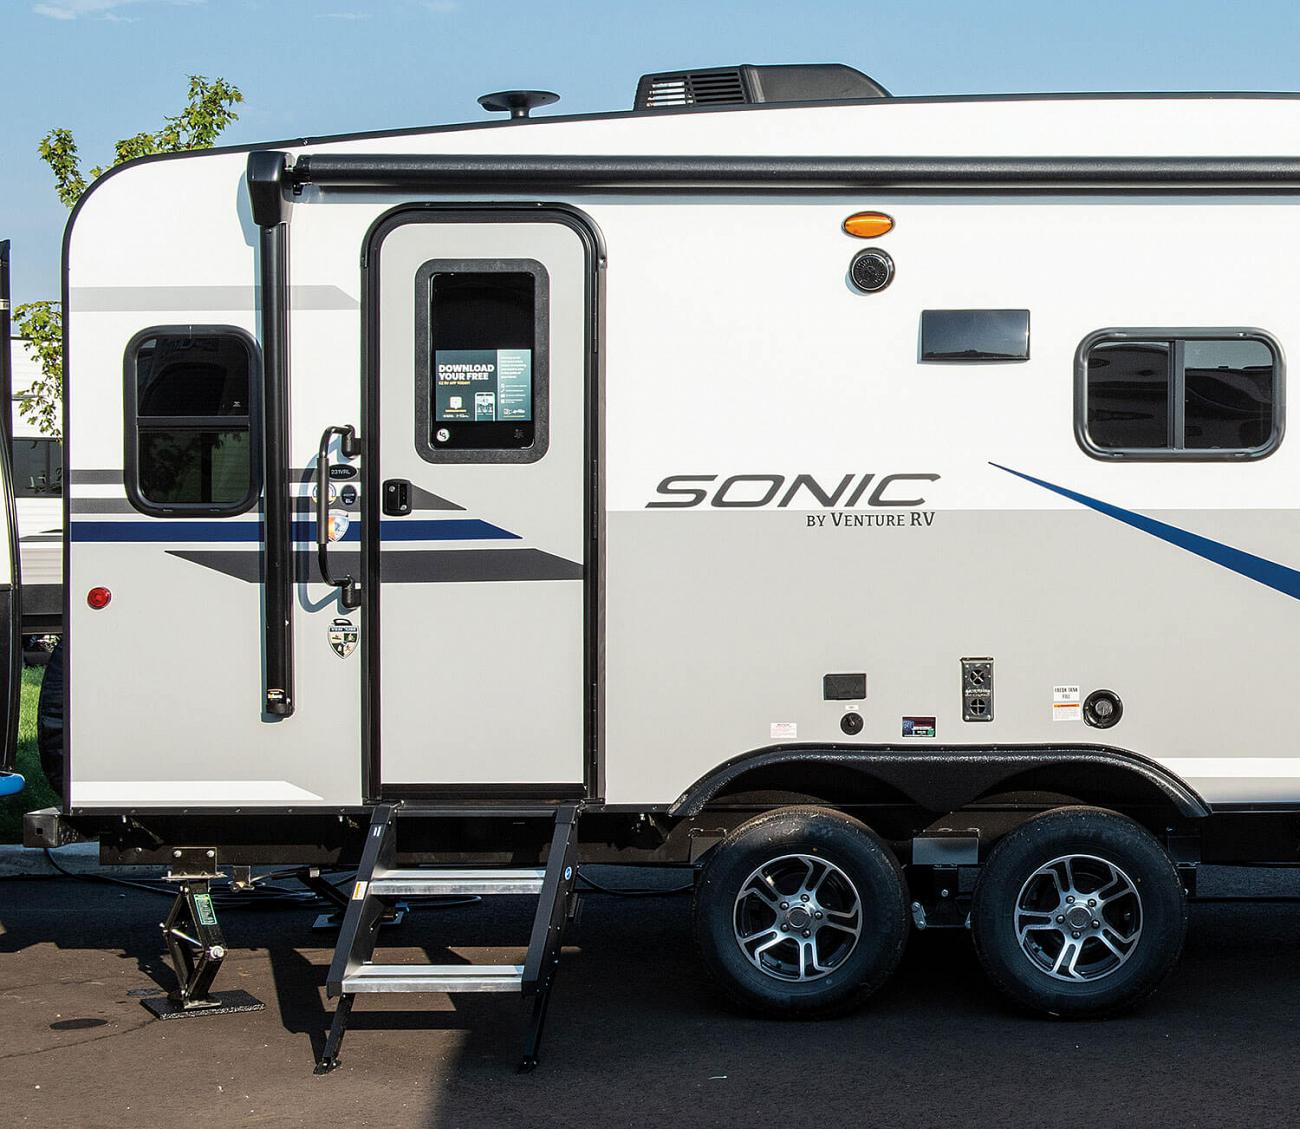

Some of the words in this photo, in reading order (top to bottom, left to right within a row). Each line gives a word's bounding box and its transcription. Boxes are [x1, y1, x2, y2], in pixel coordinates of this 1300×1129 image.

[438, 364, 495, 373] DOWNLOAD
[438, 372, 465, 381] YOUR
[466, 372, 489, 380] FREE
[645, 473, 941, 509] SONIC
[806, 514, 826, 527] BY
[829, 512, 906, 527] VENTURE
[909, 512, 935, 527] RV
